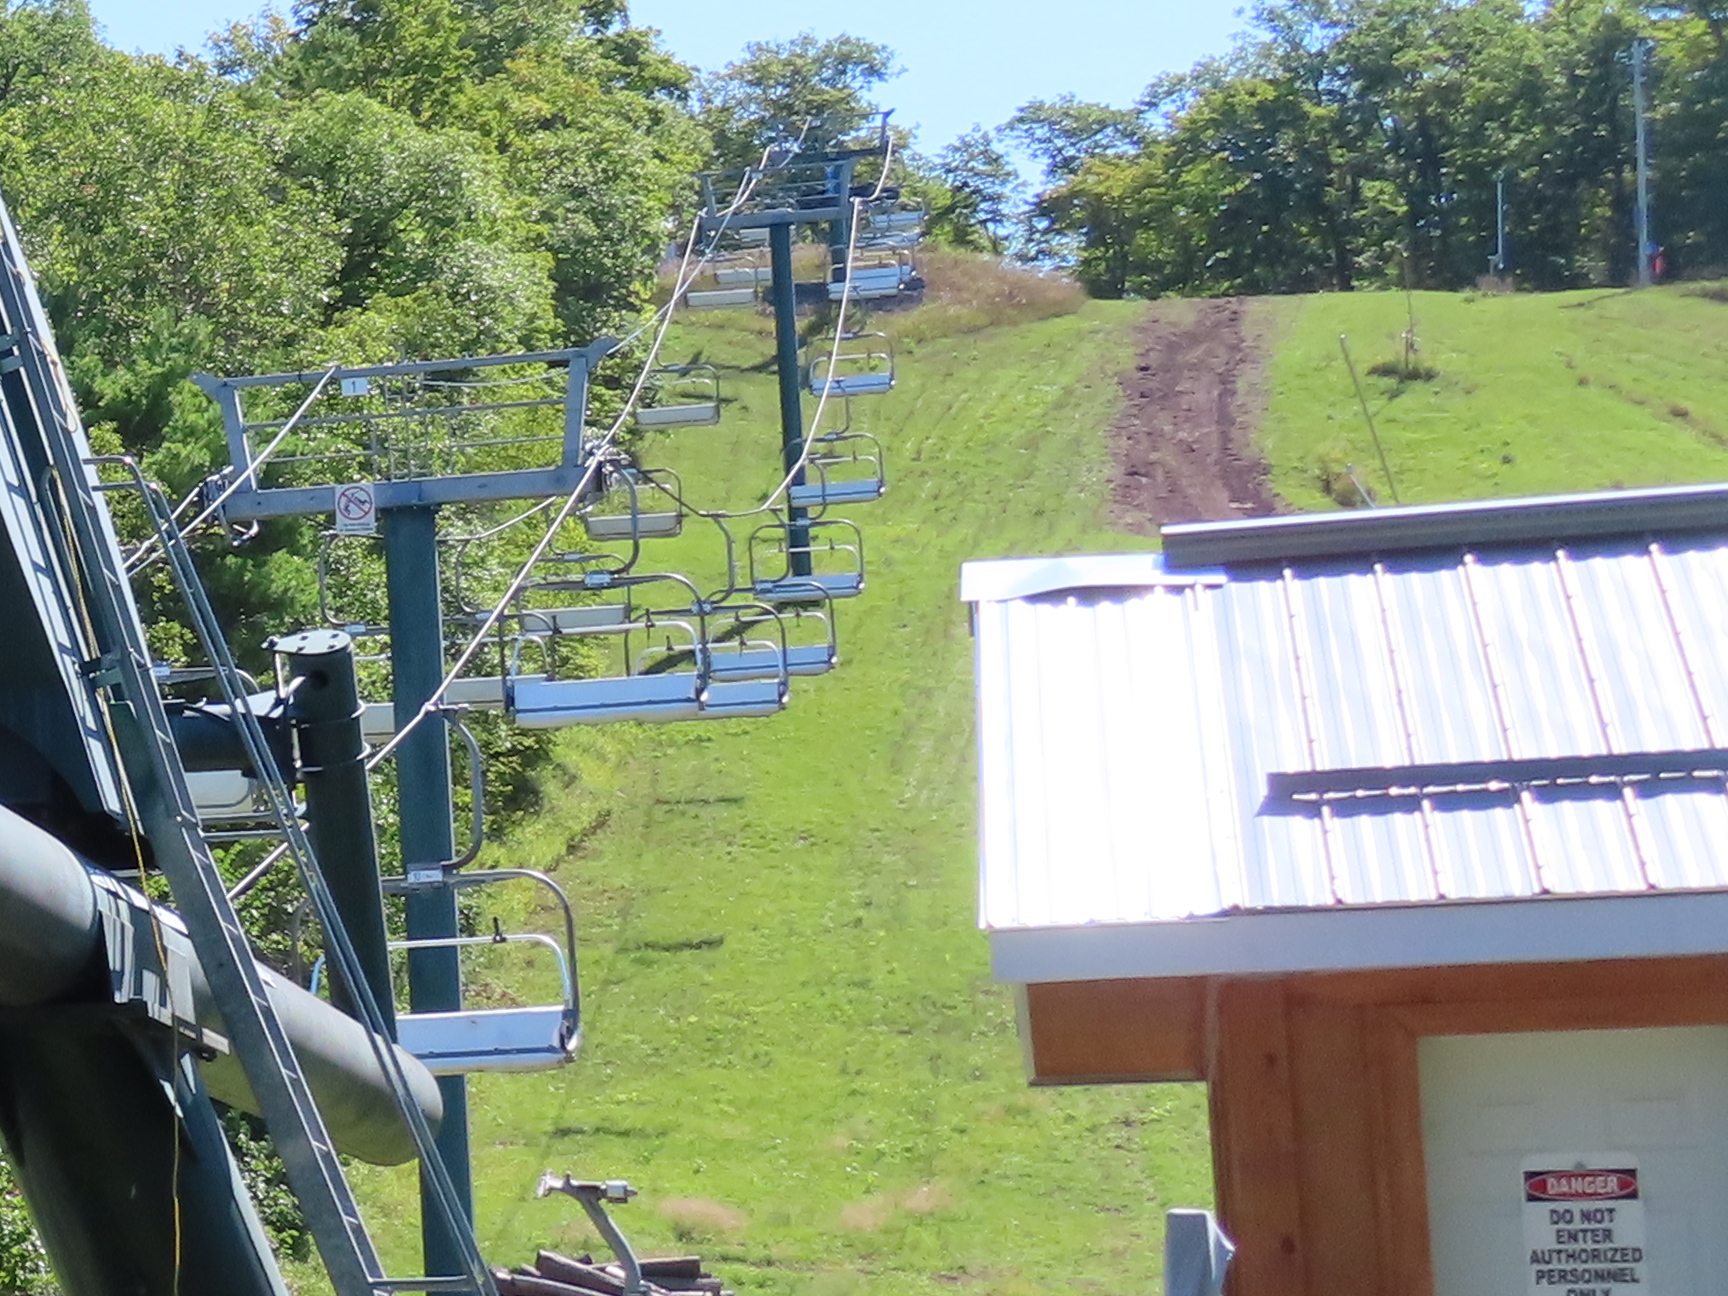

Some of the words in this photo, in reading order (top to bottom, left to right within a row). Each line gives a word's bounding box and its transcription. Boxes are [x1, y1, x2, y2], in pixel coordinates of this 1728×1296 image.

[1546, 1176, 1619, 1195] DANGER
[1549, 1209, 1574, 1225] DO
[1579, 1208, 1617, 1224] NOT
[1555, 1228, 1614, 1245] ENTER
[1529, 1248, 1643, 1265] AUTHORIZED
[1535, 1267, 1640, 1285] PERSONNEL
